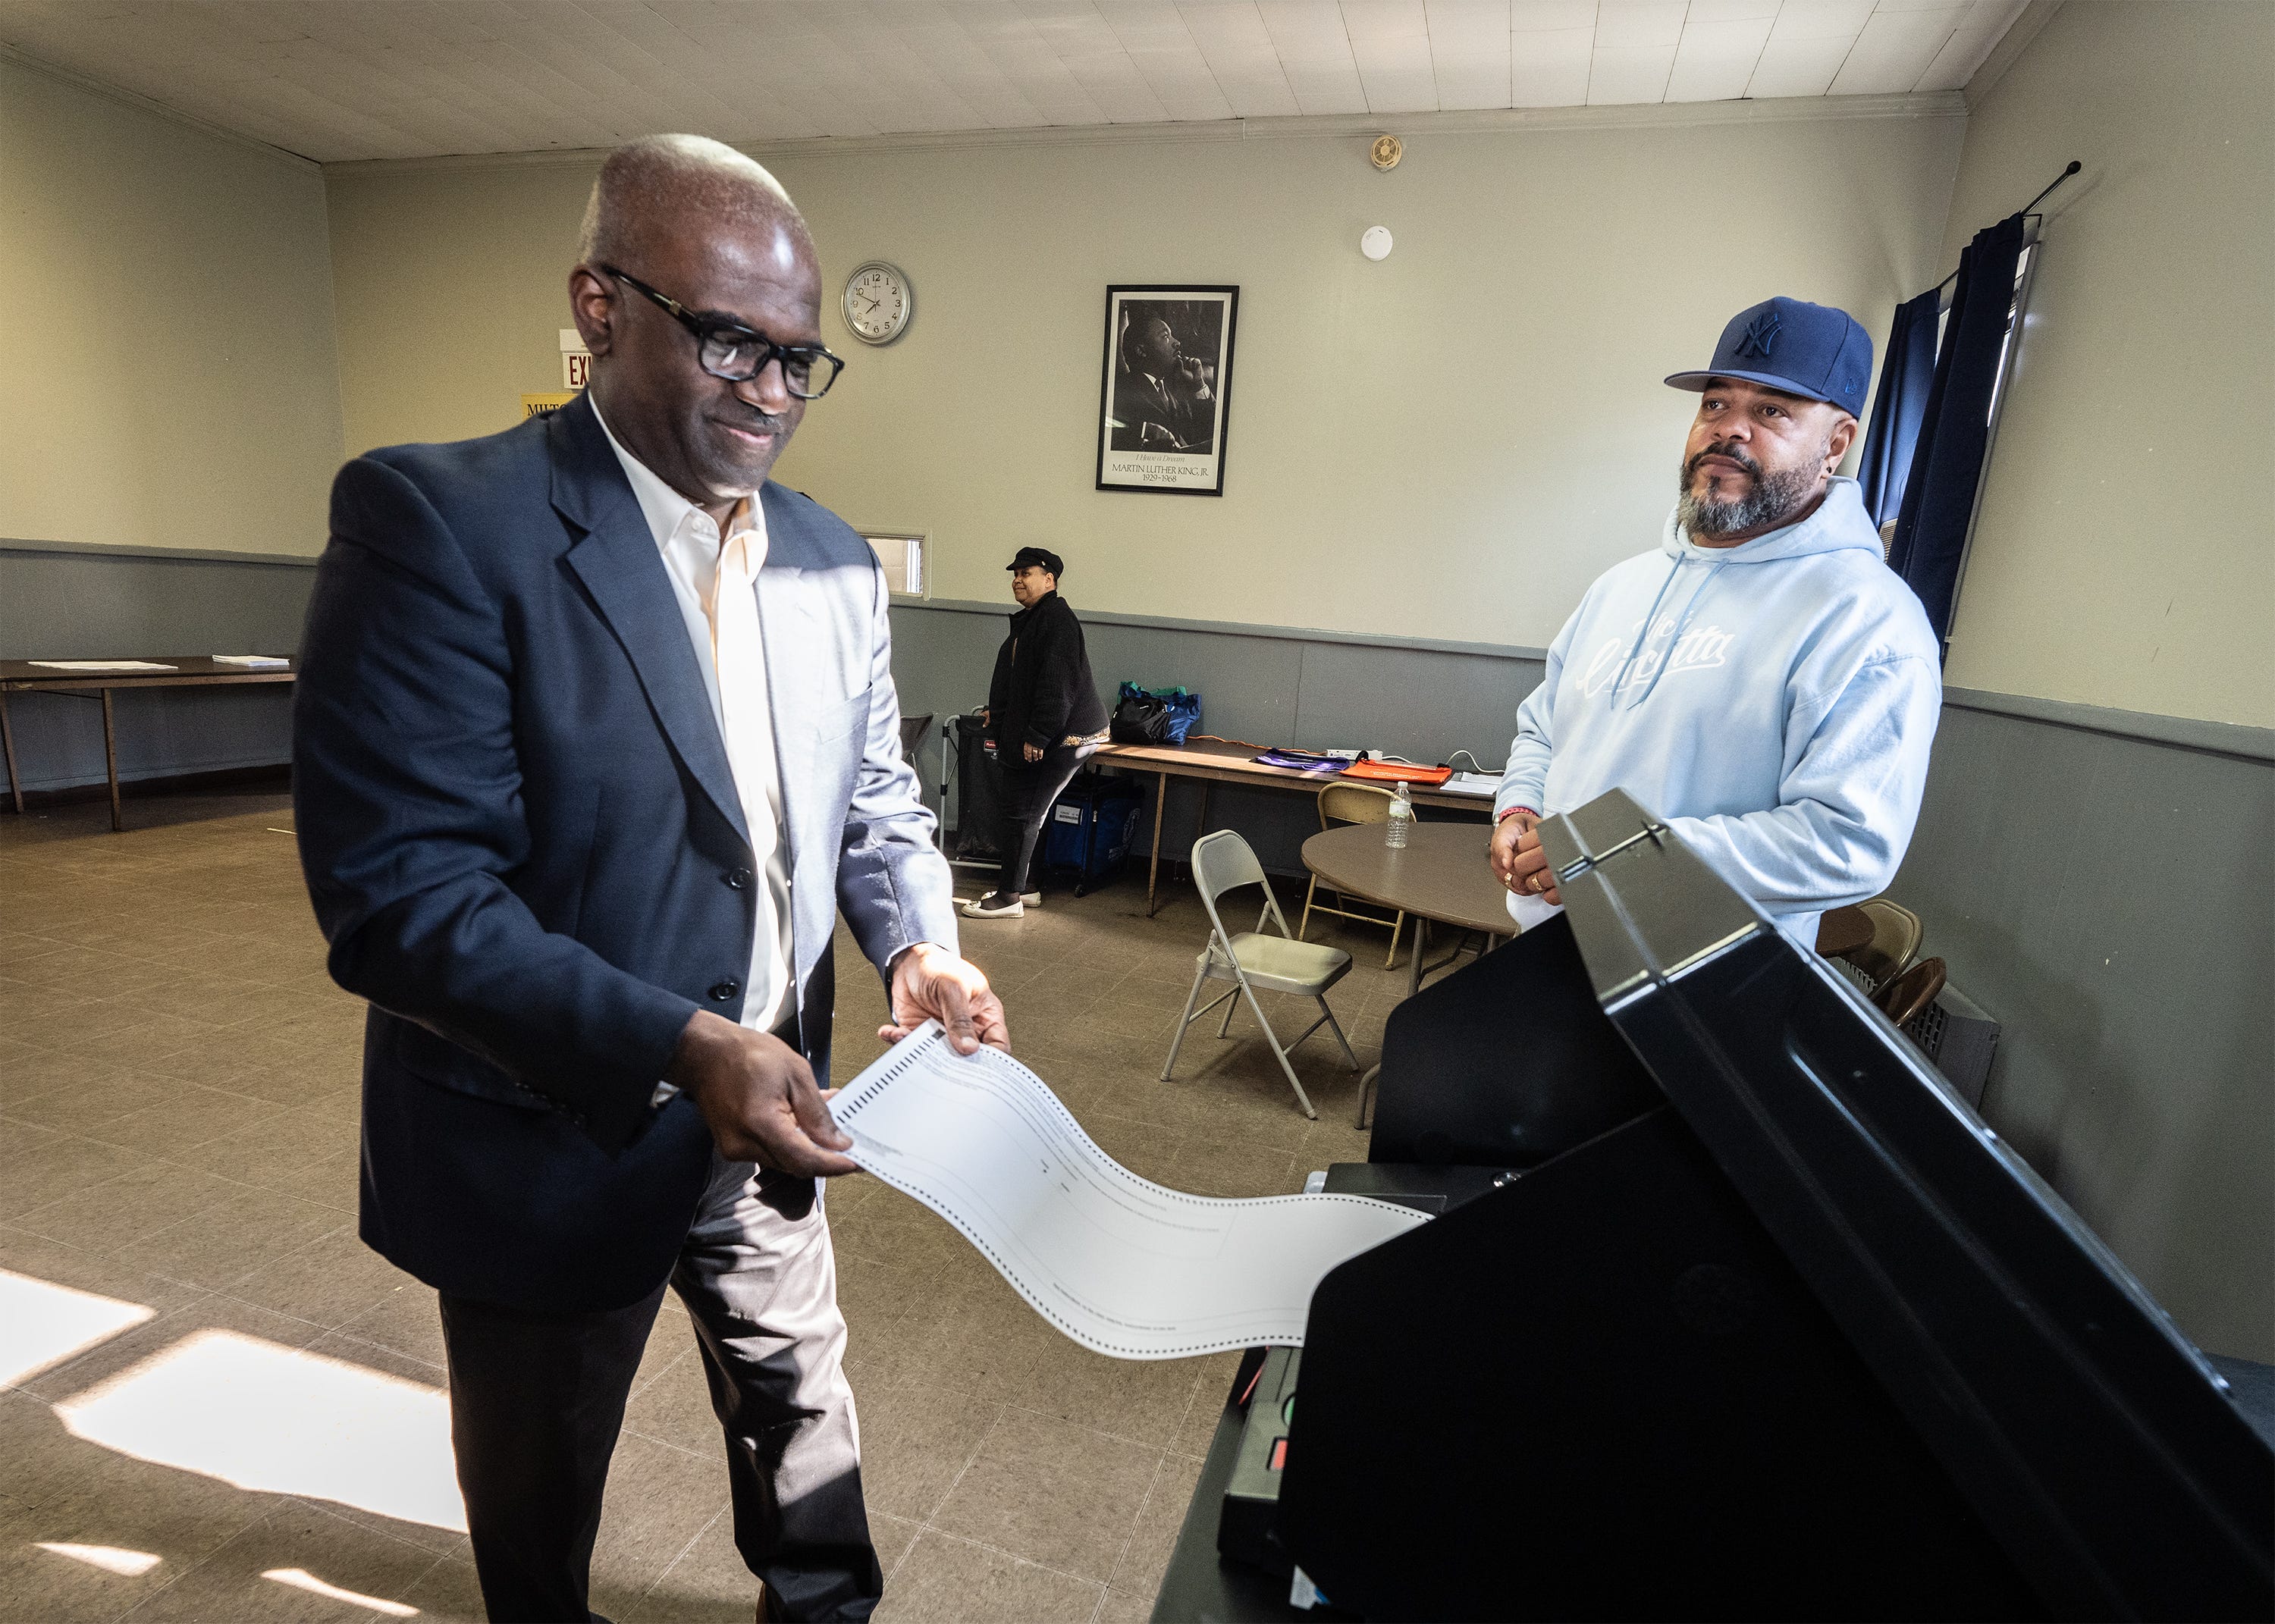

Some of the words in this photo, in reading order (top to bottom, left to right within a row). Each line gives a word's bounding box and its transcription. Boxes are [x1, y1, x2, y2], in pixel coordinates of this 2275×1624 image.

[1734, 313, 1782, 357] NY
[1112, 463, 1145, 473] MARTIN
[1146, 465, 1176, 474] LUTHER
[1178, 466, 1200, 477] KING,
[1143, 473, 1177, 482] 1929-1968
